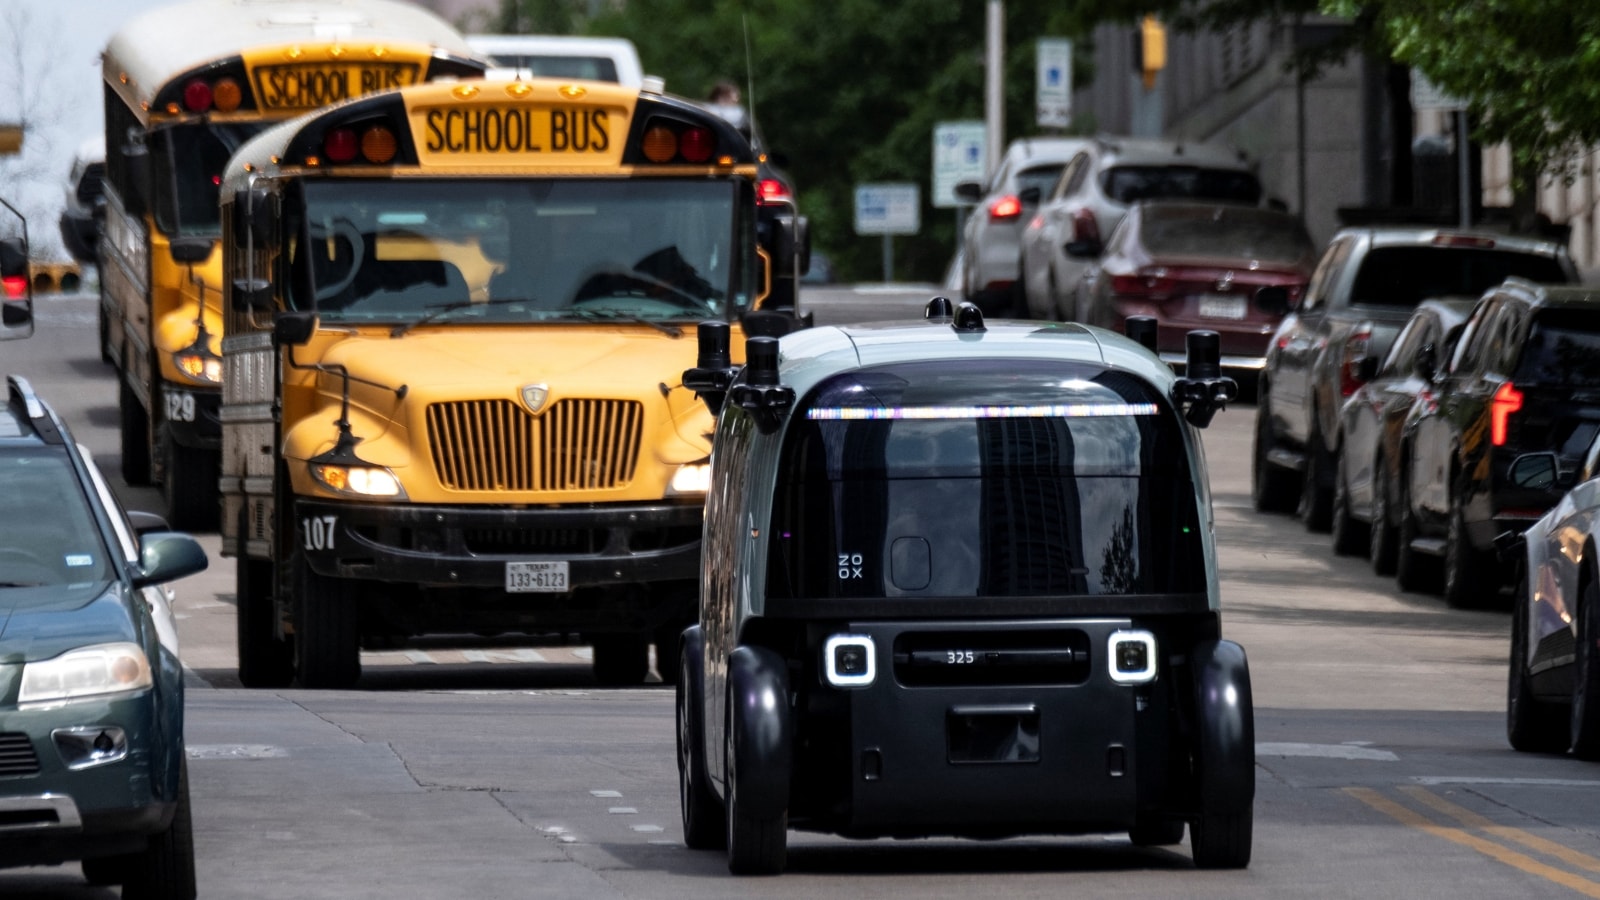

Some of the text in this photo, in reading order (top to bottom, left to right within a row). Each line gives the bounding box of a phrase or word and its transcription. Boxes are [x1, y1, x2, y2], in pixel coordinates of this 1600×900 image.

[269, 69, 350, 107] SCHOOL
[427, 108, 609, 152] SCHOOL BUS
[163, 392, 195, 421] 129
[302, 516, 336, 550] 107
[947, 651, 974, 664] 325
